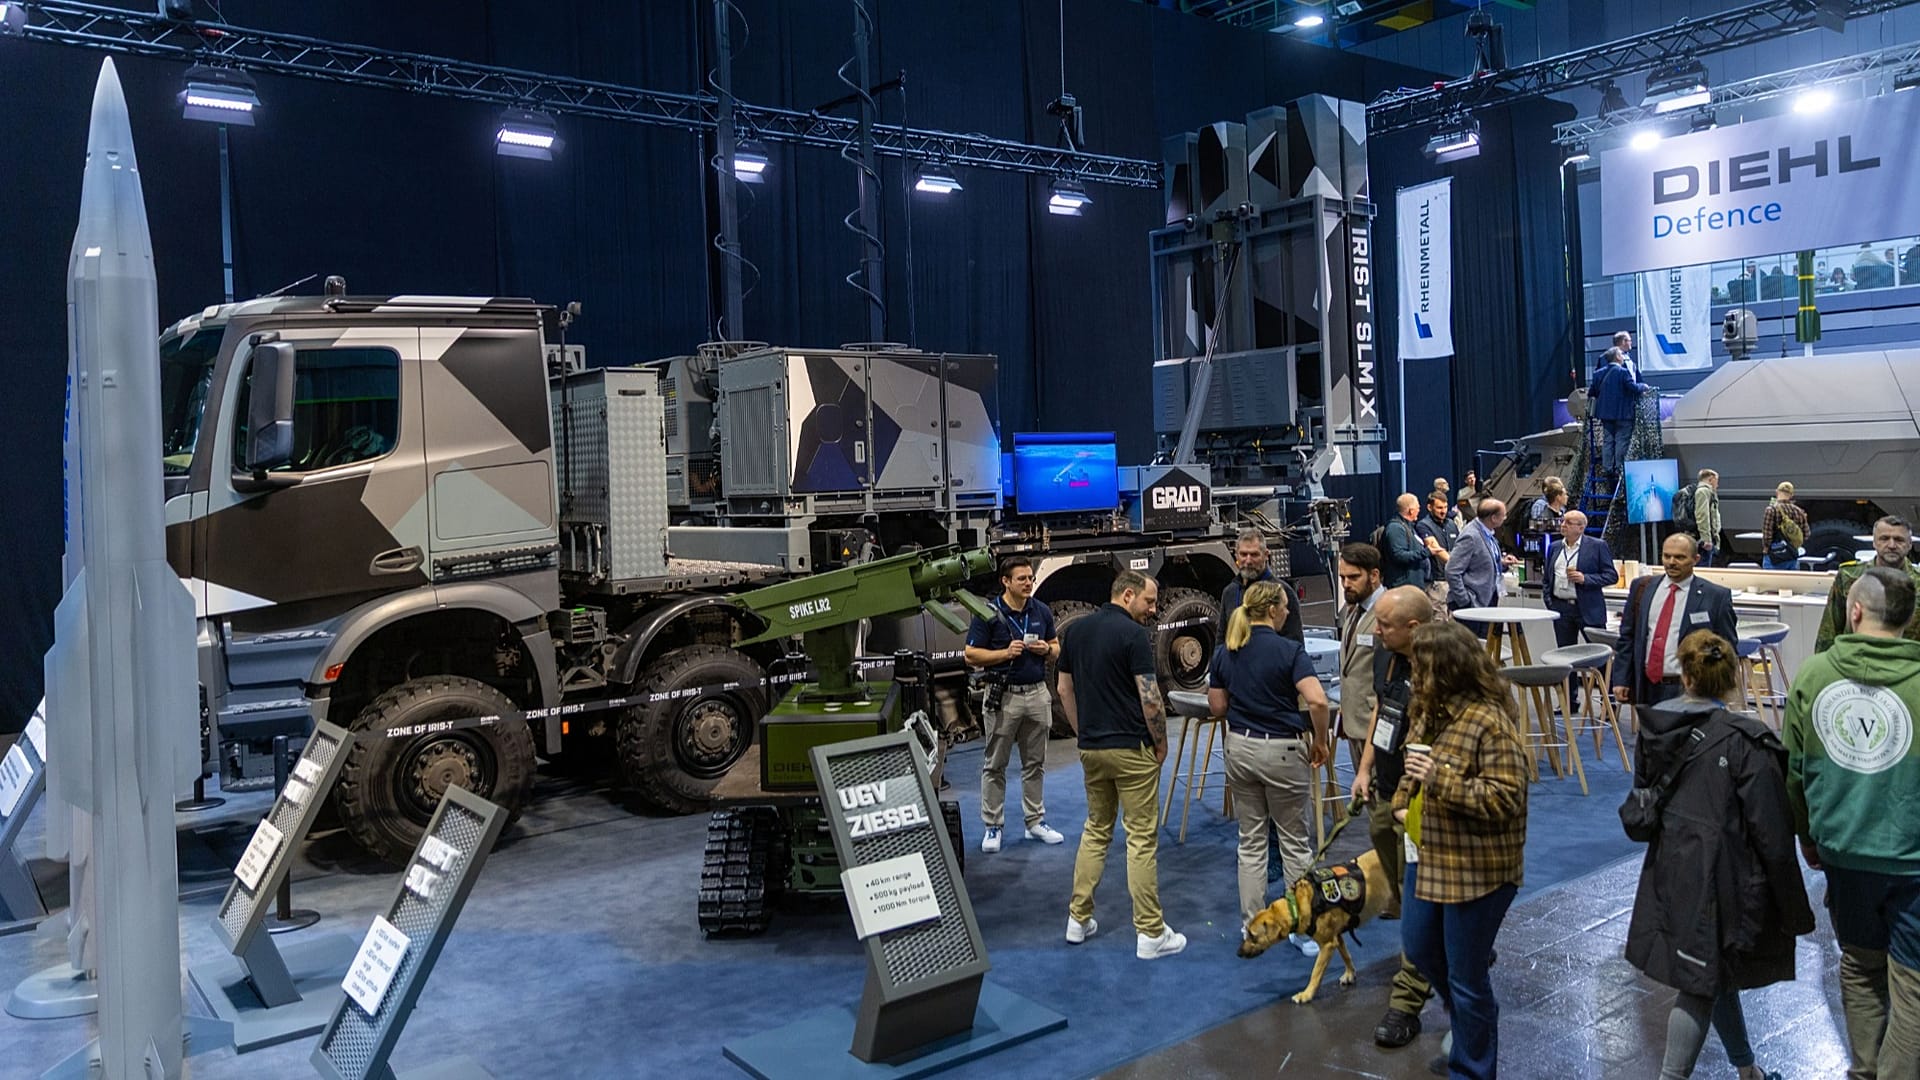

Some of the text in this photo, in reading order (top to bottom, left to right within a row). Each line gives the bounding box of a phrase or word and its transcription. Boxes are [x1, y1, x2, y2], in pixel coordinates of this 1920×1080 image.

[1653, 135, 1880, 205] DIEHL
[1654, 202, 1782, 239] Defence
[1420, 199, 1430, 313] RHEINMETALL
[1351, 227, 1371, 313] IRIS-T
[1669, 267, 1682, 334] RHEINMET
[1152, 485, 1202, 509] GRAD
[789, 597, 832, 620] SPIKE LR2
[649, 687, 702, 702] ZONE OF IRIS-T
[526, 703, 585, 720] ZONE OF IRIS-T
[387, 720, 454, 738] ZONE OF IRIS-T
[773, 762, 813, 773] DIEH
[836, 781, 887, 810] UGV
[845, 803, 929, 837] ZIESEL
[870, 871, 912, 887] 40 km range
[889, 887, 898, 899] kg
[899, 880, 925, 896] payload
[878, 894, 931, 912] 1000 Nm torque
